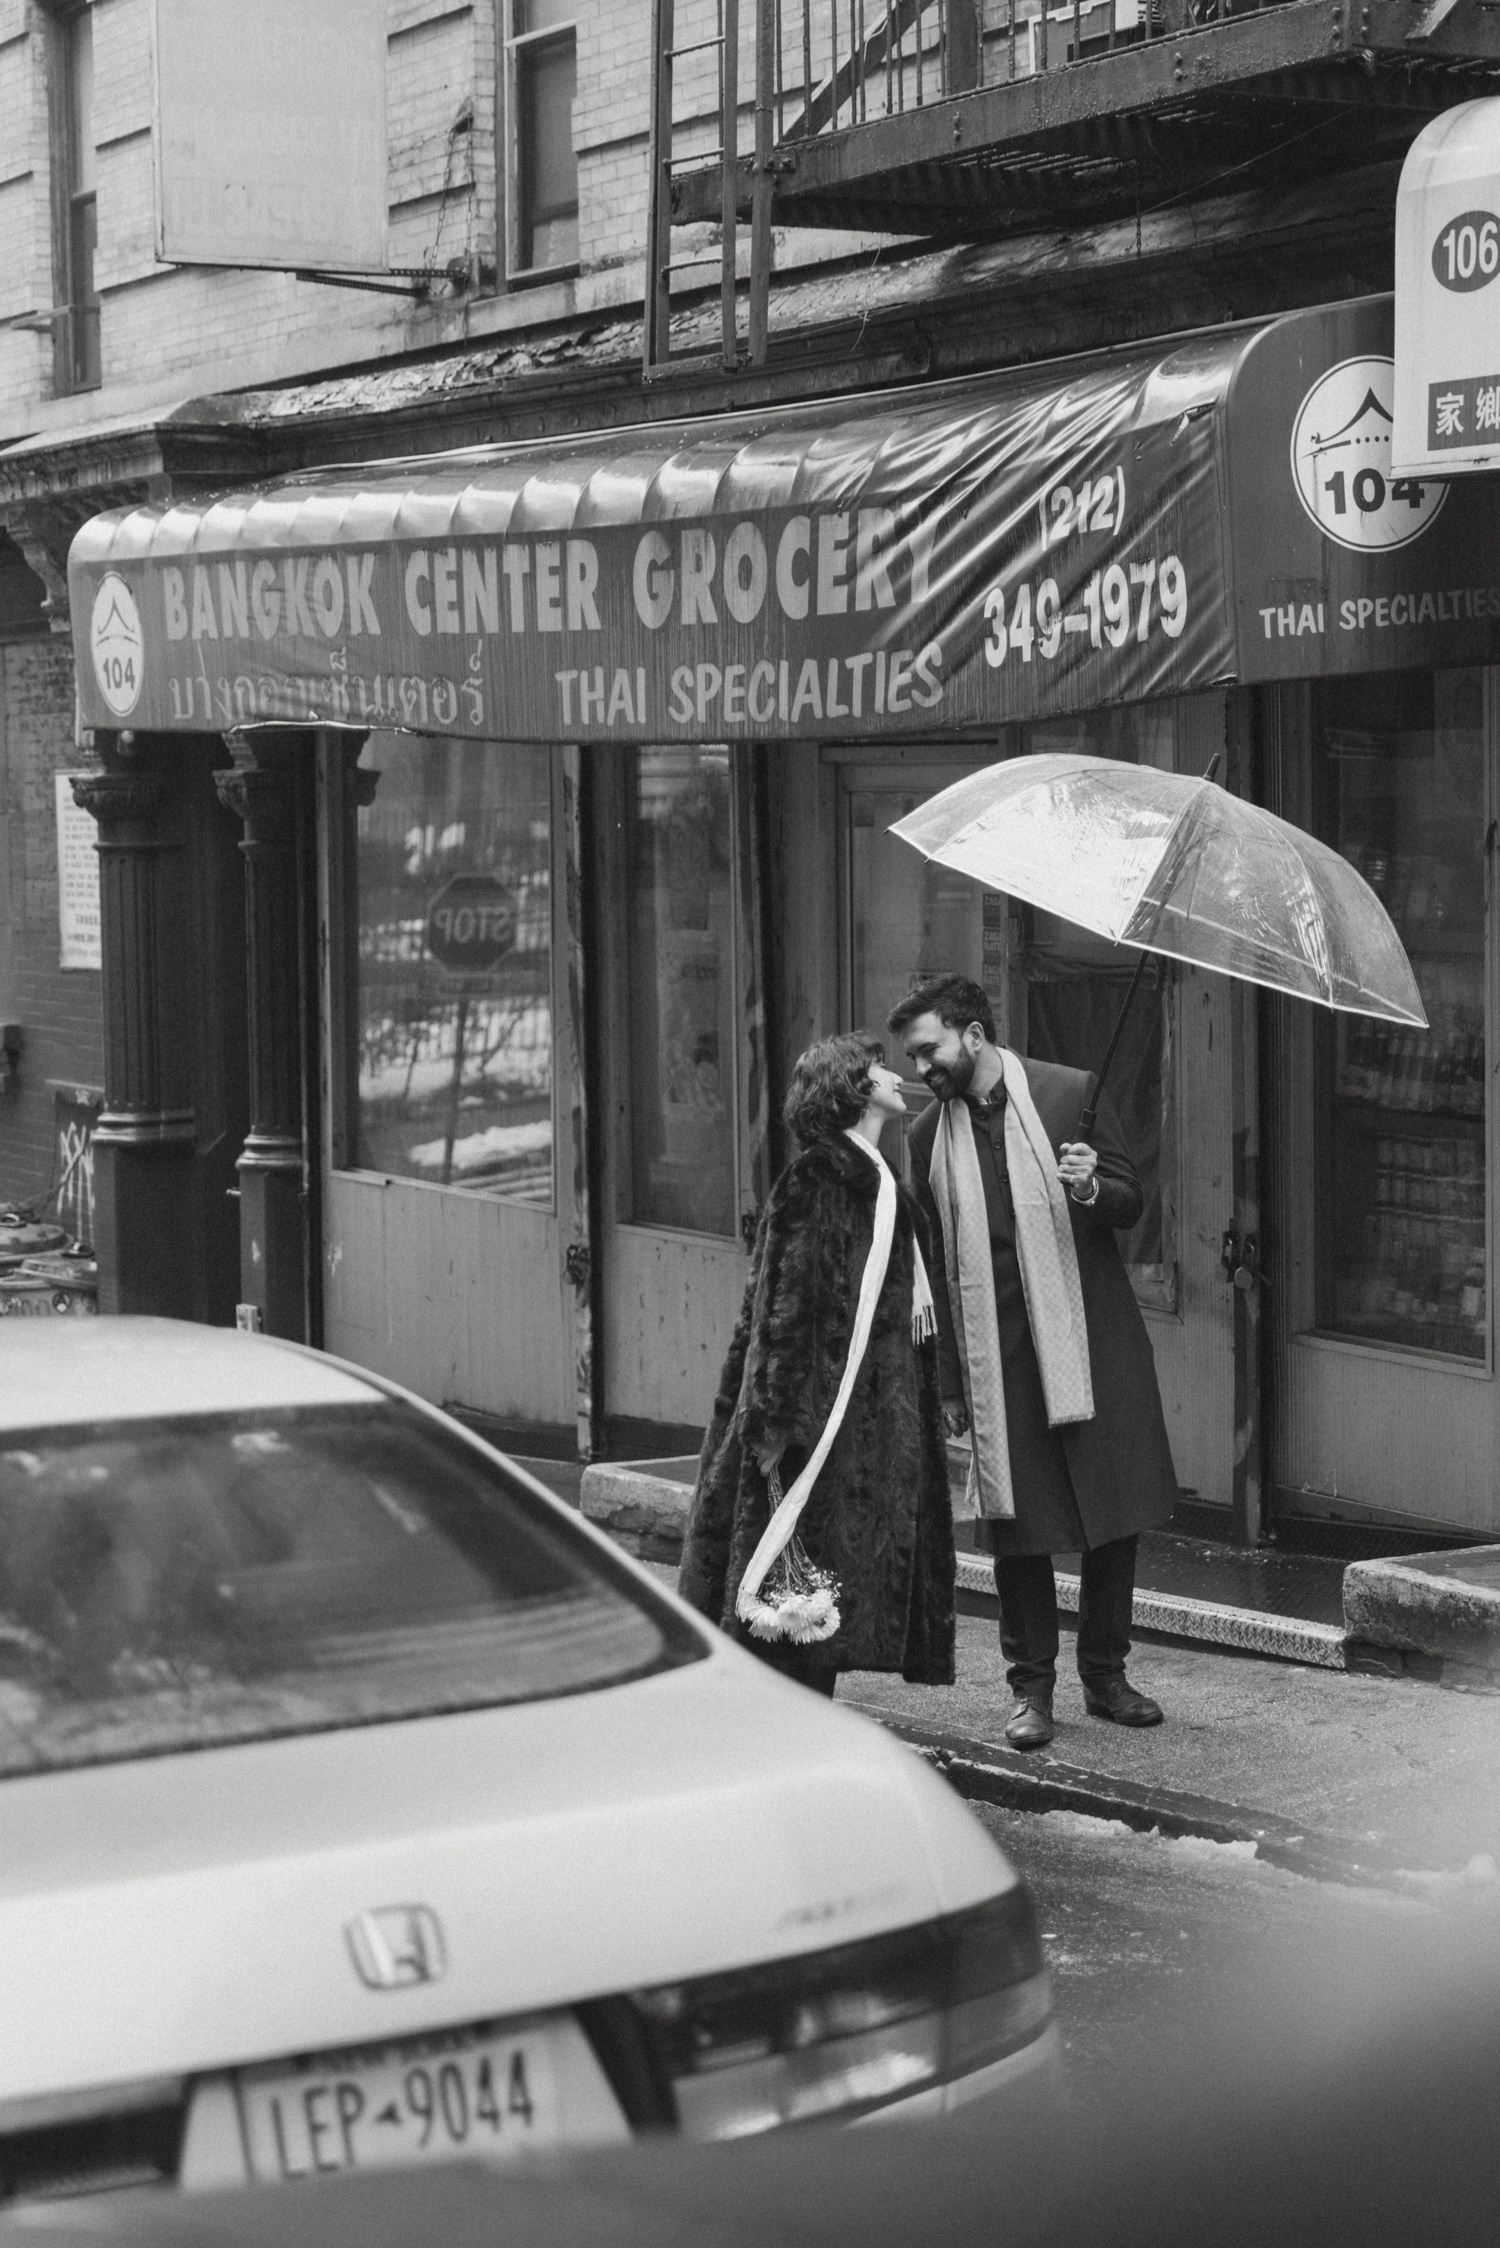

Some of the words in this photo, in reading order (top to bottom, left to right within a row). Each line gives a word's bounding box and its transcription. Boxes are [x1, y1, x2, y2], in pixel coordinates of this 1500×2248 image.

[1443, 220, 1499, 280] 106
[1039, 465, 1126, 551] (212)
[1324, 467, 1426, 515] 104
[163, 553, 382, 640] BANGKOK
[404, 538, 601, 636] CENTER
[633, 500, 941, 630] GROCERY
[983, 554, 1188, 669] 349-1979
[1258, 602, 1324, 639] THAI
[1339, 586, 1500, 631] SPECIALTIES
[103, 657, 136, 690] 104
[554, 665, 647, 727] THAI
[668, 641, 943, 724] SPECIALTIES
